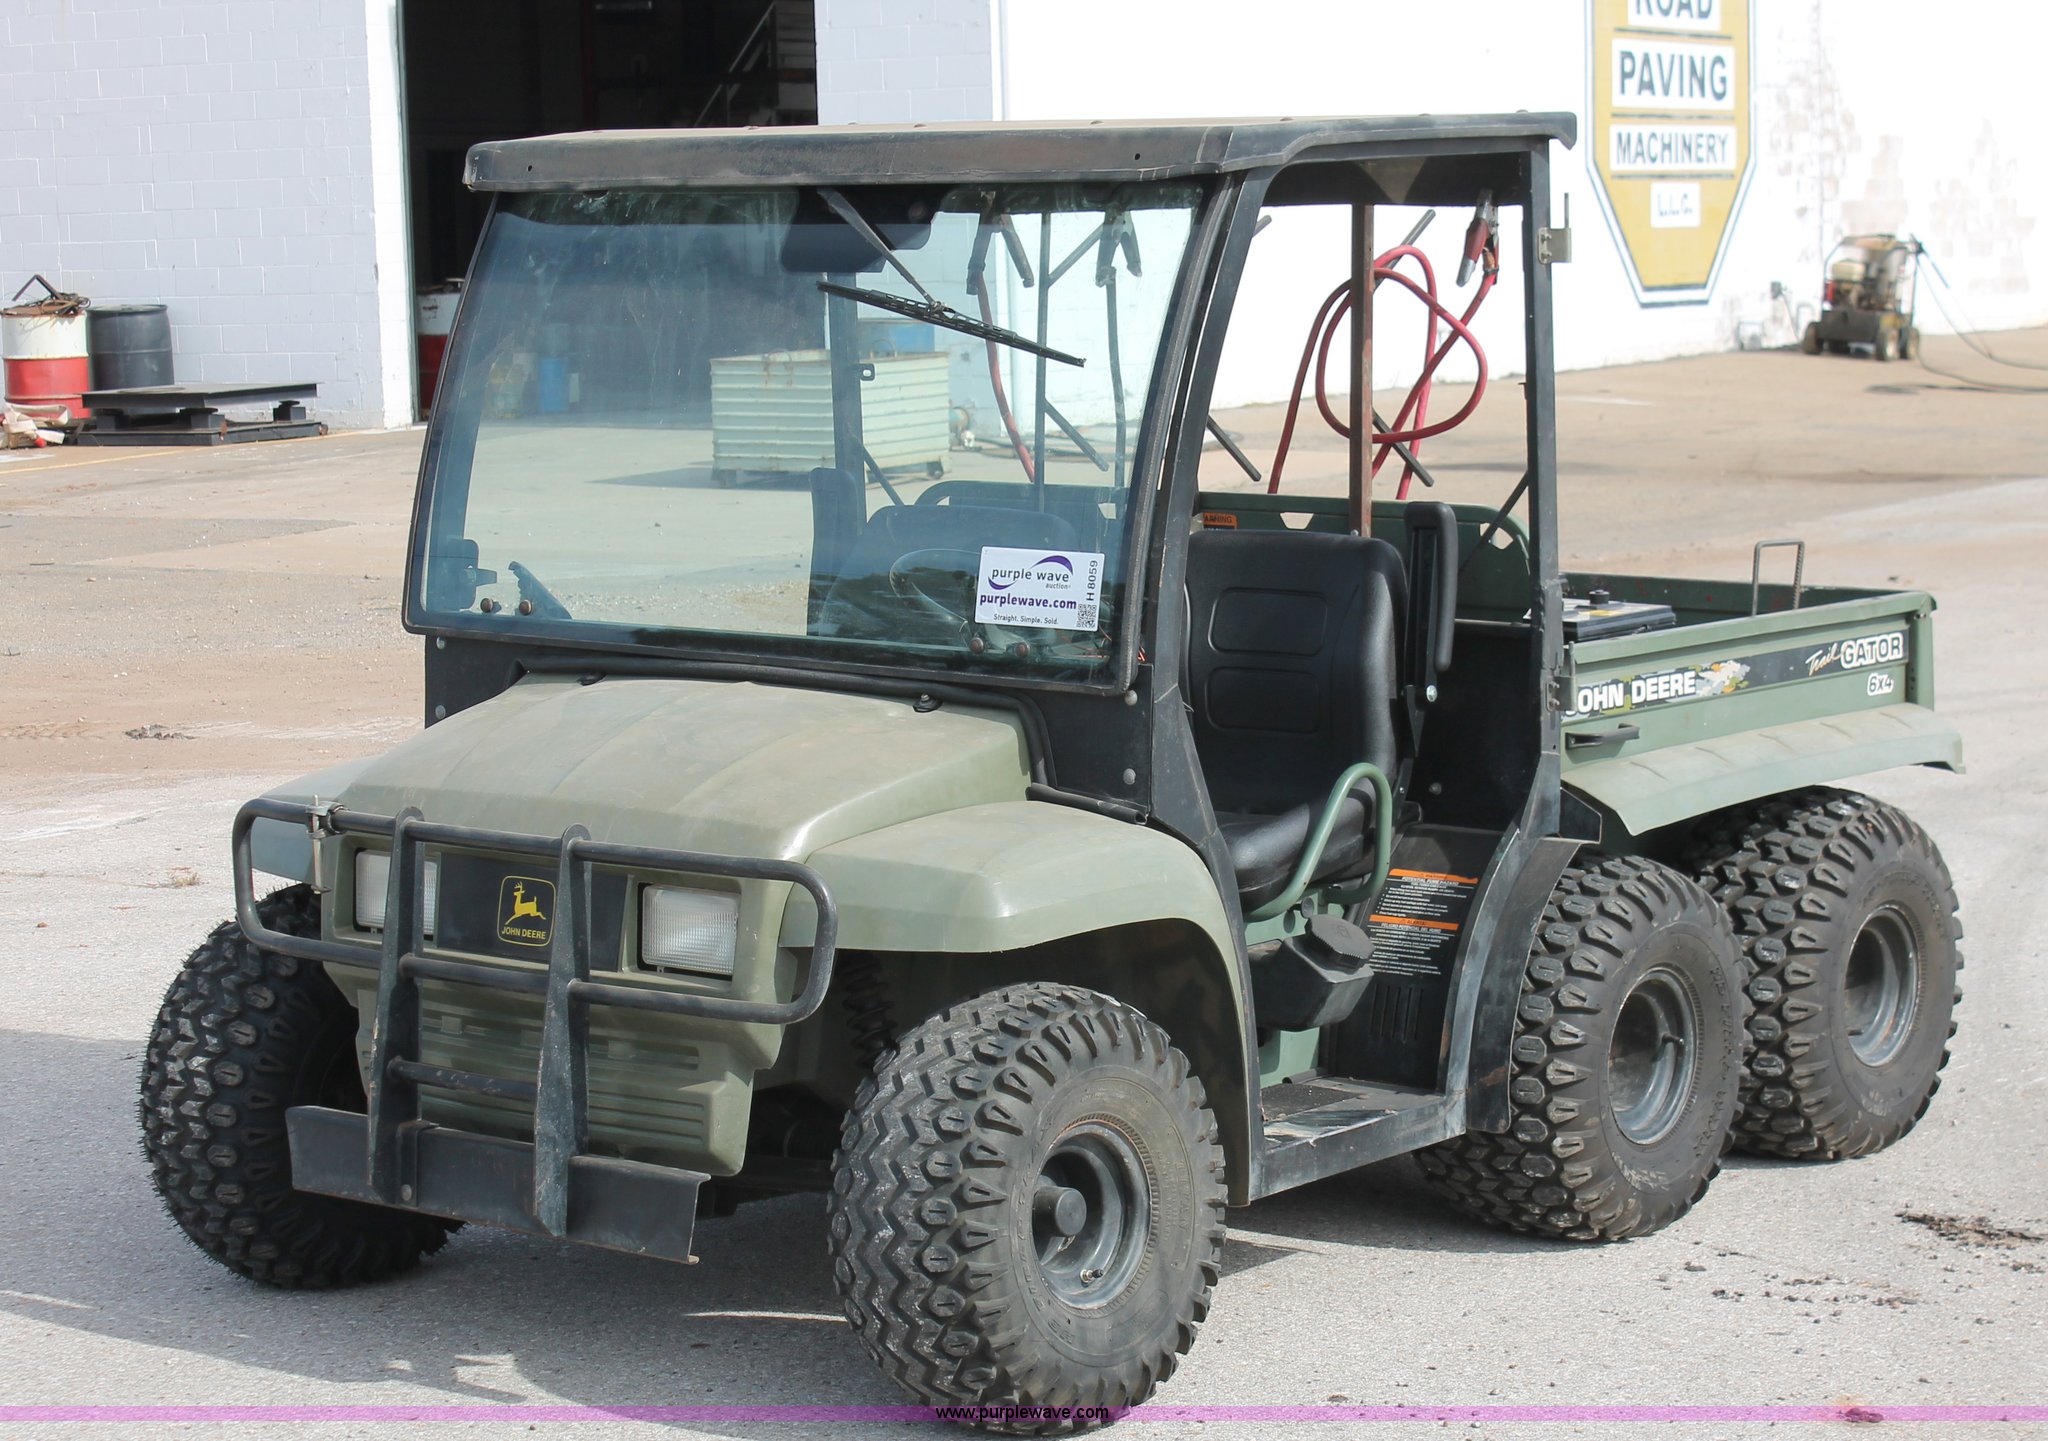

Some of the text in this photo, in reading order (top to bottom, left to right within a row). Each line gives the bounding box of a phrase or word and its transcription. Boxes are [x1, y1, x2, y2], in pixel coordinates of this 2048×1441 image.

[1619, 51, 1728, 101] PAVING
[1616, 131, 1729, 165] MACHINERY
[991, 568, 1069, 582] purple wave
[1086, 560, 1098, 601] H 8059
[980, 593, 1077, 610] purplewave.com
[993, 613, 1059, 625] Straight. Simple. Sold.
[1841, 632, 1903, 669] GATOR
[1565, 670, 1696, 715] OHN DEERE
[501, 926, 547, 939] JOHN DEERE
